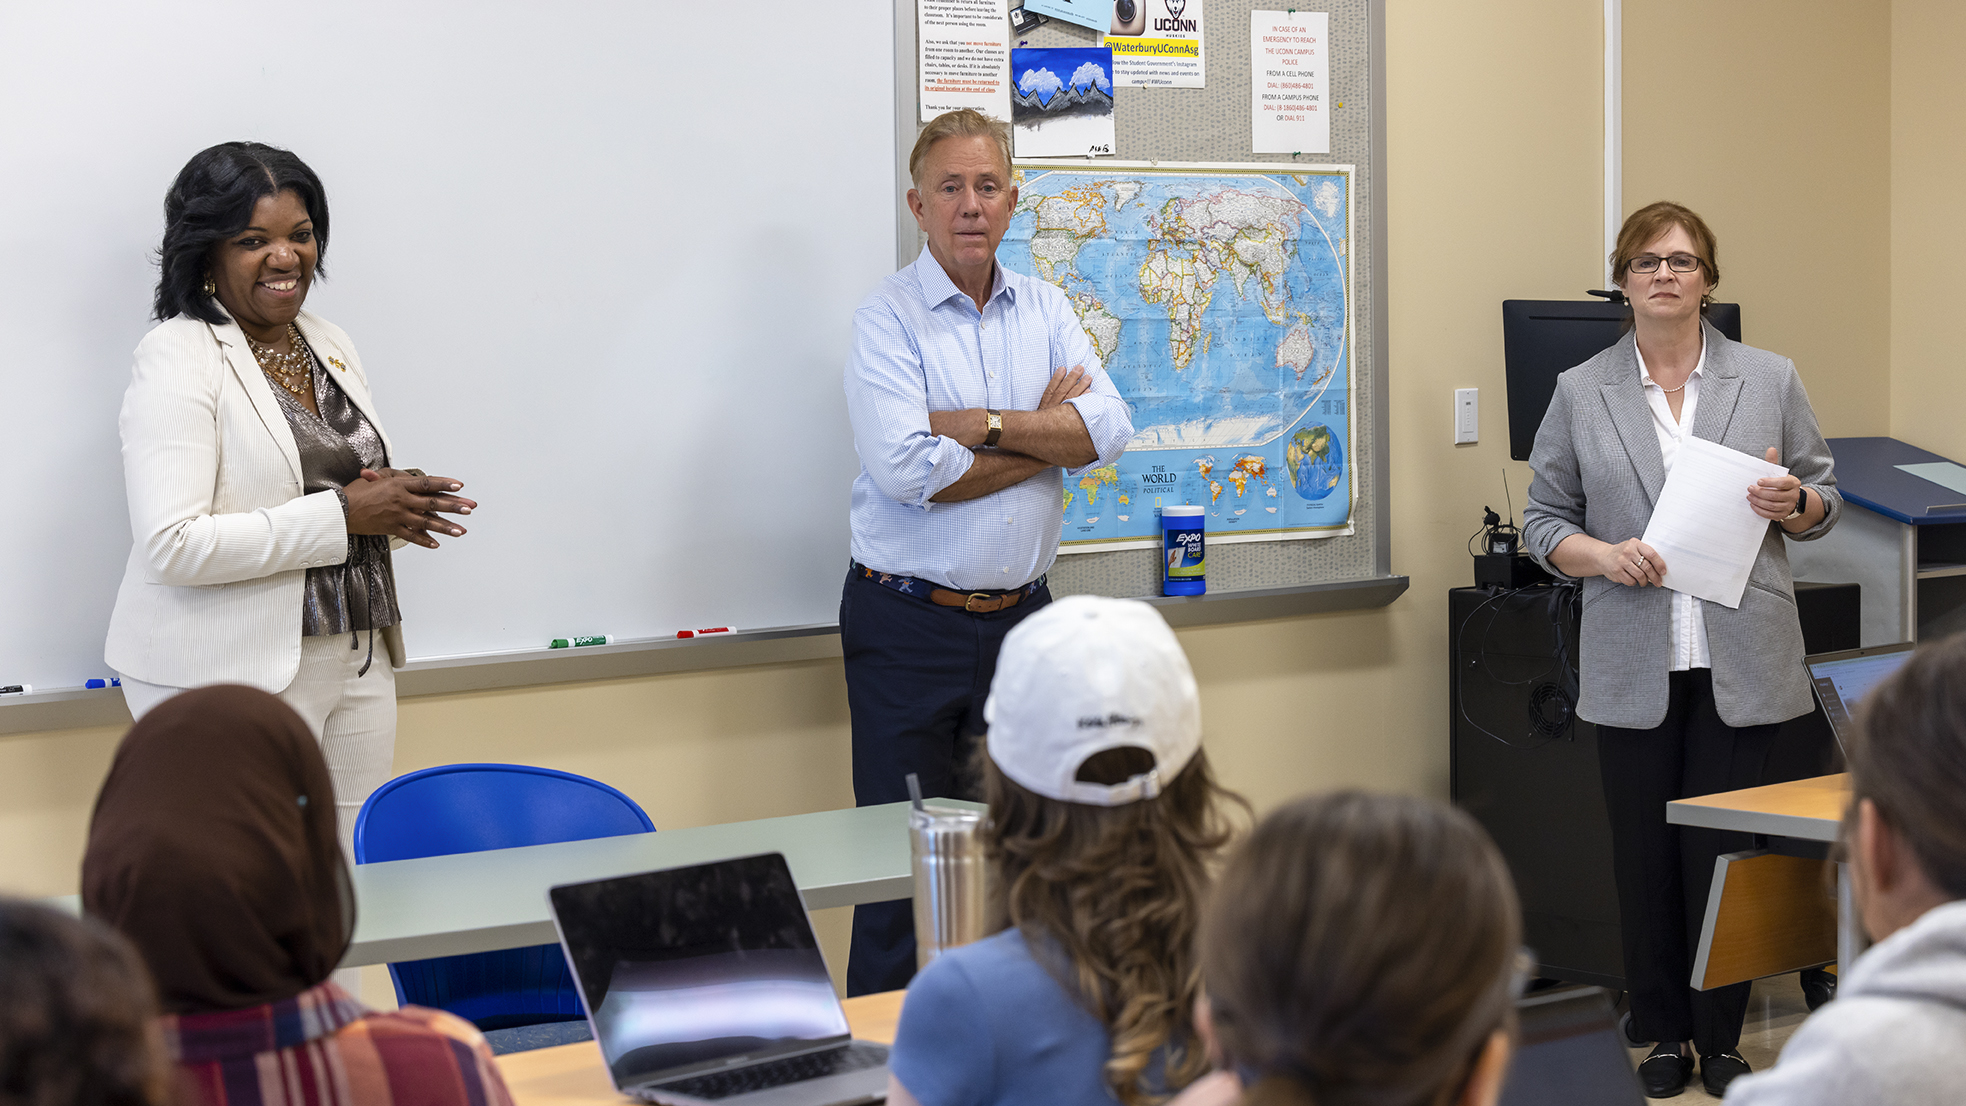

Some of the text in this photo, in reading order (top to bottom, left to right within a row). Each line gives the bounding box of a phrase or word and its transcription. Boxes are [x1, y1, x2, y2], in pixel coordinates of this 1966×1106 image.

[1154, 18, 1196, 32] UCONN
[1142, 473, 1176, 483] WORLD
[1176, 533, 1201, 545] EXPO
